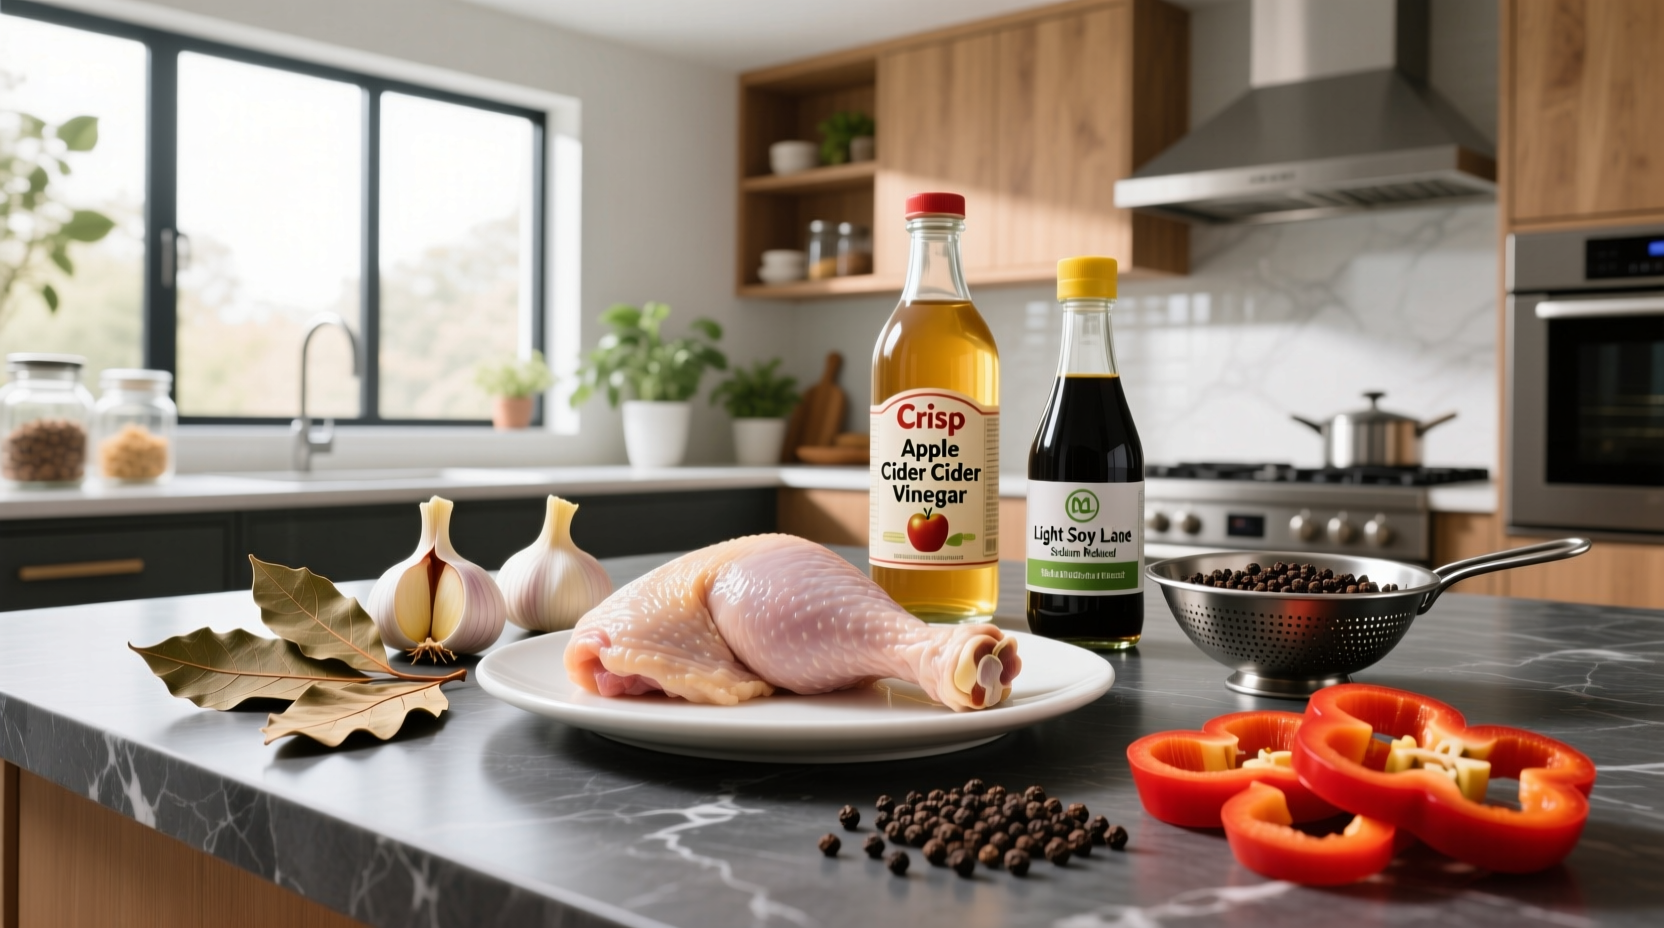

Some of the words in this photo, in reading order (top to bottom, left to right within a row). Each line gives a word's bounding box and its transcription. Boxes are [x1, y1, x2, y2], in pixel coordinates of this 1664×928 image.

[897, 403, 966, 436] Crisp
[901, 438, 960, 462] Apple
[881, 462, 926, 481] Cider
[931, 463, 981, 482] Cider
[893, 485, 967, 508] Vinegar
[1034, 525, 1063, 545] Light
[1067, 527, 1096, 546] Soy
